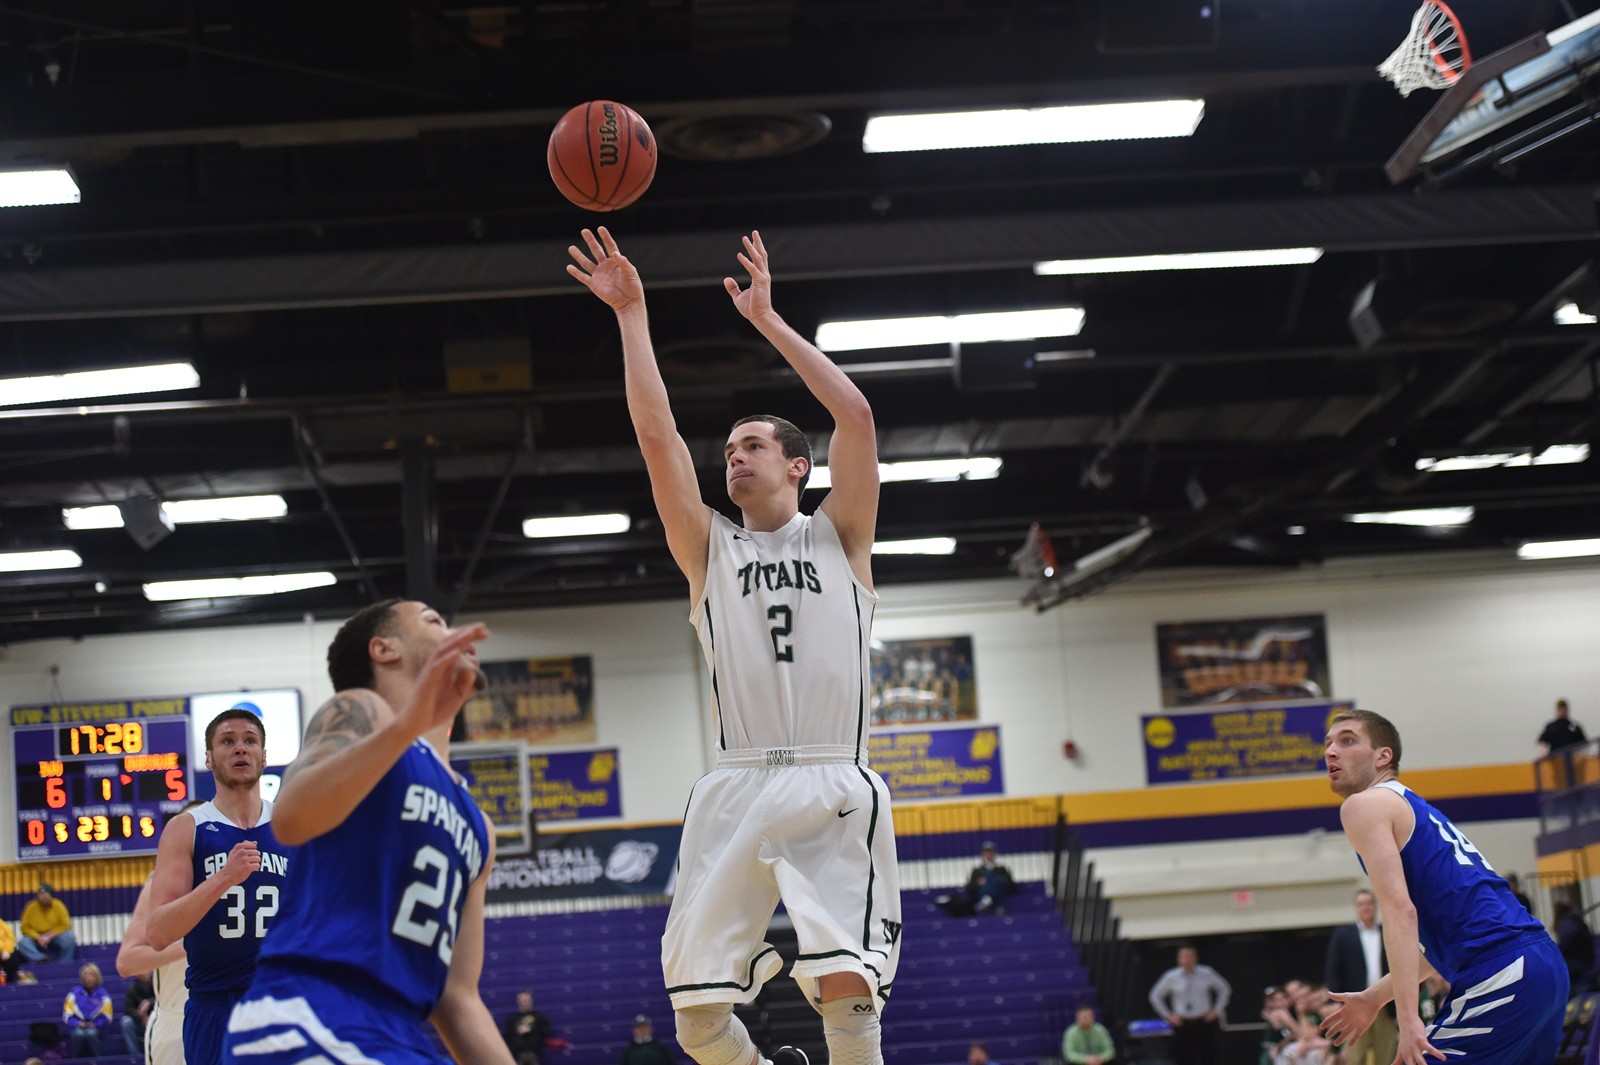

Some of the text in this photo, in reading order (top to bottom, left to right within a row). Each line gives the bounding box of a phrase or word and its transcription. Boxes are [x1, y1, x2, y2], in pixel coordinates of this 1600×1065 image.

[598, 103, 619, 168] Wilson
[767, 604, 795, 663] 2
[13, 698, 186, 726] UW-STEVENS POINT
[70, 722, 143, 755] 17:28
[766, 749, 795, 765] IWU
[46, 777, 67, 808] 6
[102, 778, 112, 801] 1
[165, 769, 186, 801] 5
[27, 820, 45, 846] 0
[54, 822, 69, 843] 5
[77, 815, 110, 842] 23
[122, 815, 132, 838] 1
[139, 816, 155, 838] 5
[1428, 813, 1495, 872] 14
[219, 885, 280, 939] 32
